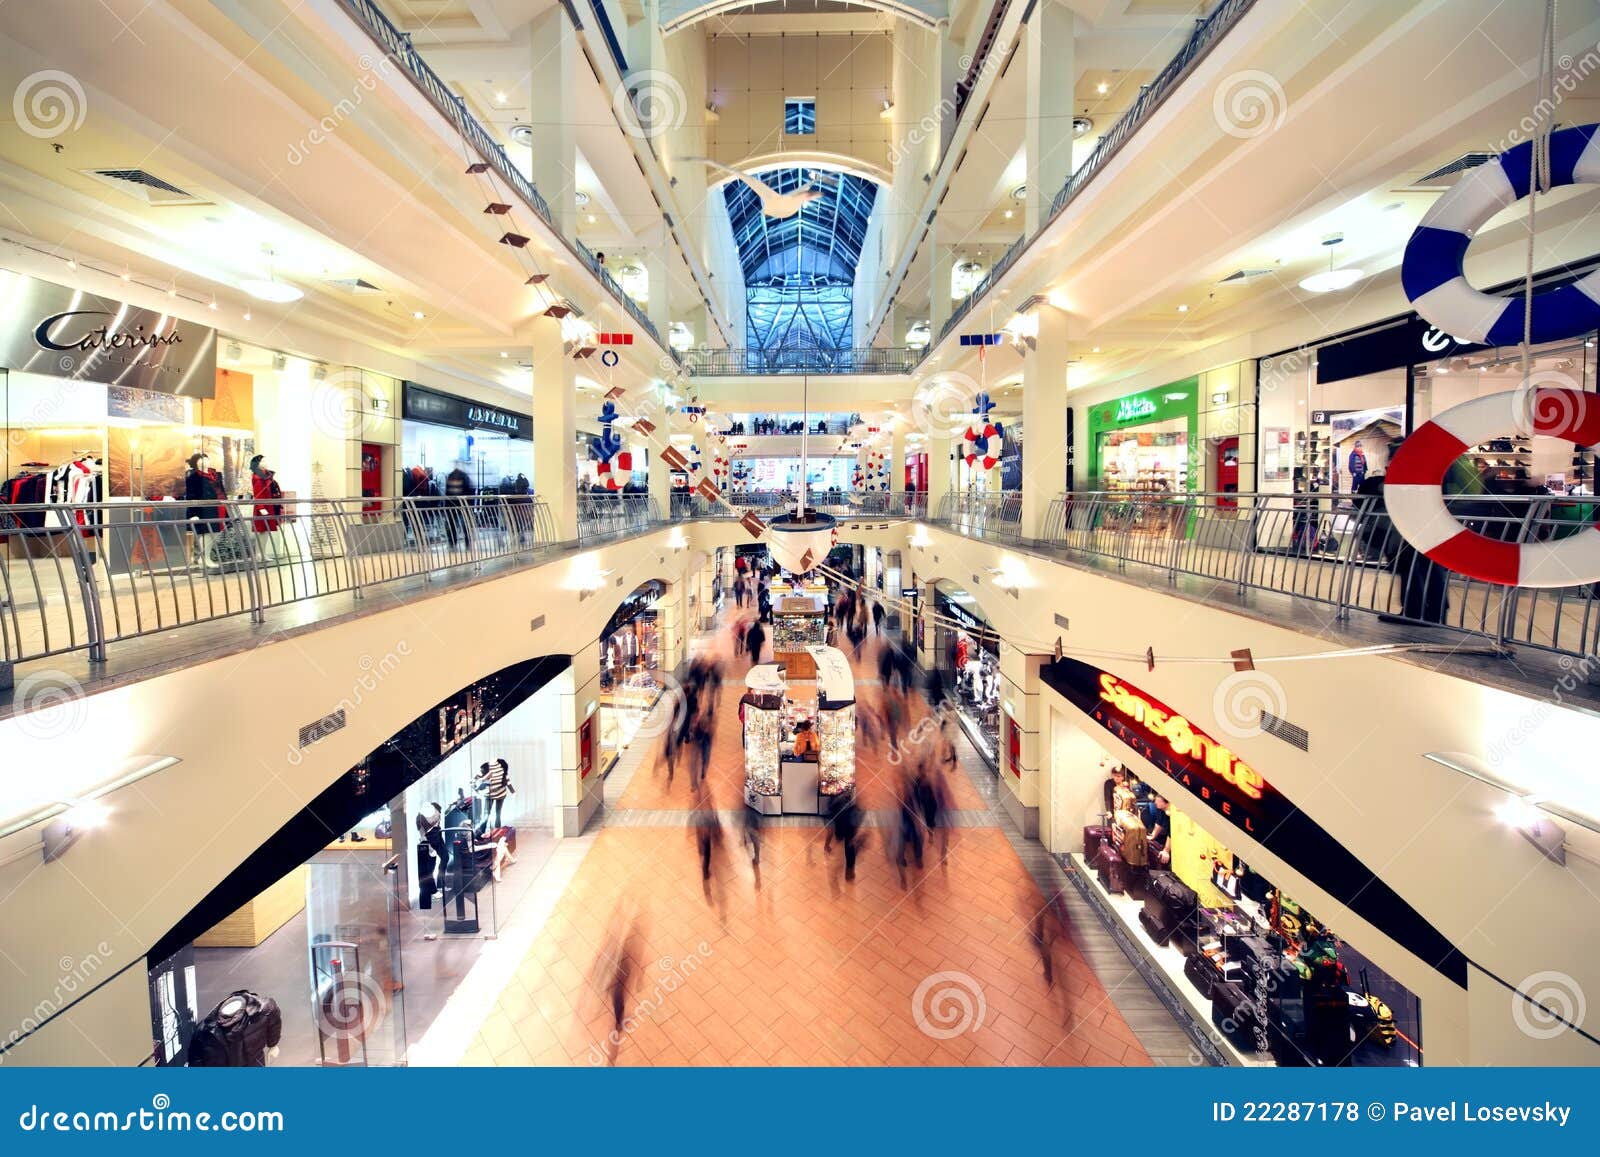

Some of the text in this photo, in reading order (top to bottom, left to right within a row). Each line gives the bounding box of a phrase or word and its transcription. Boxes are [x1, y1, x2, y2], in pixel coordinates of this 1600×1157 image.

[35, 310, 183, 351] Caterina
[1095, 711, 1254, 832] BLACK LABEL
